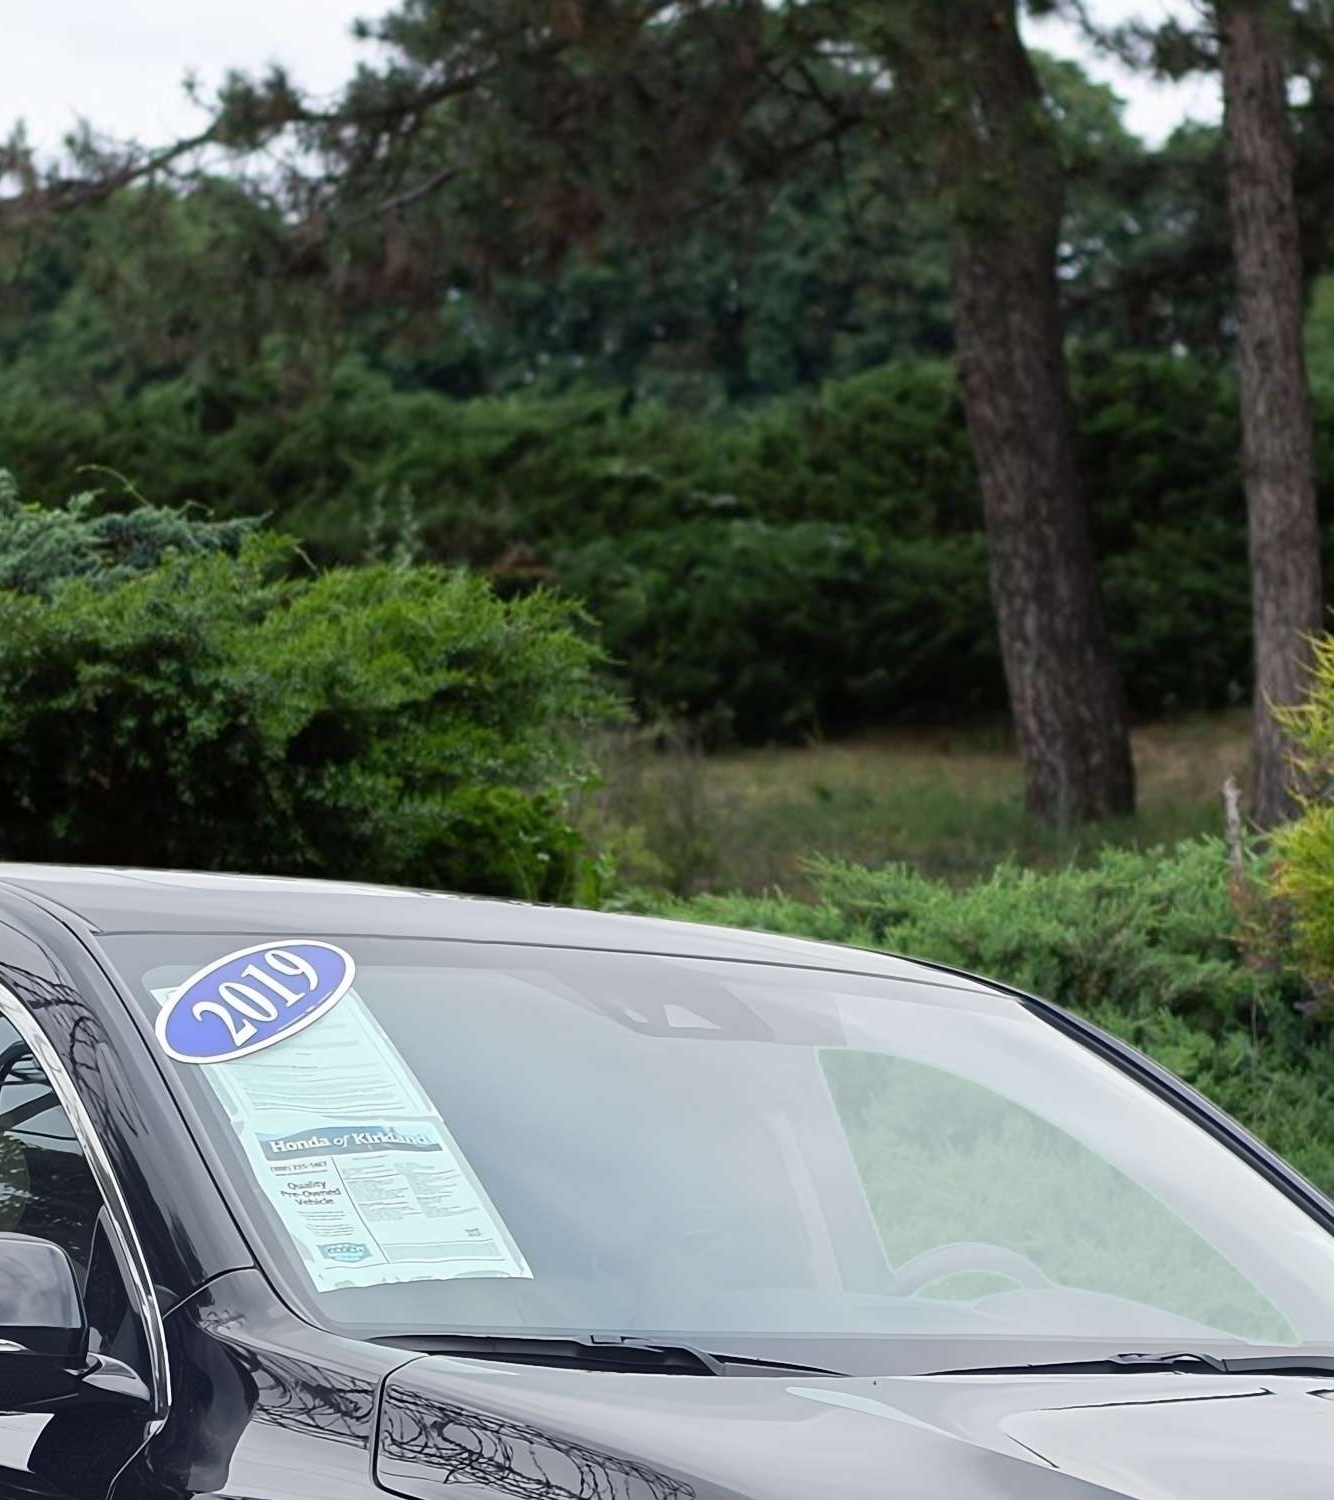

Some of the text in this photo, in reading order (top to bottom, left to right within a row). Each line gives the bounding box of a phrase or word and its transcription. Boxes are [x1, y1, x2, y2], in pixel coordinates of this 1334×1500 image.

[192, 948, 320, 1047] 2019
[269, 1131, 430, 1153] Honda of Kirkland
